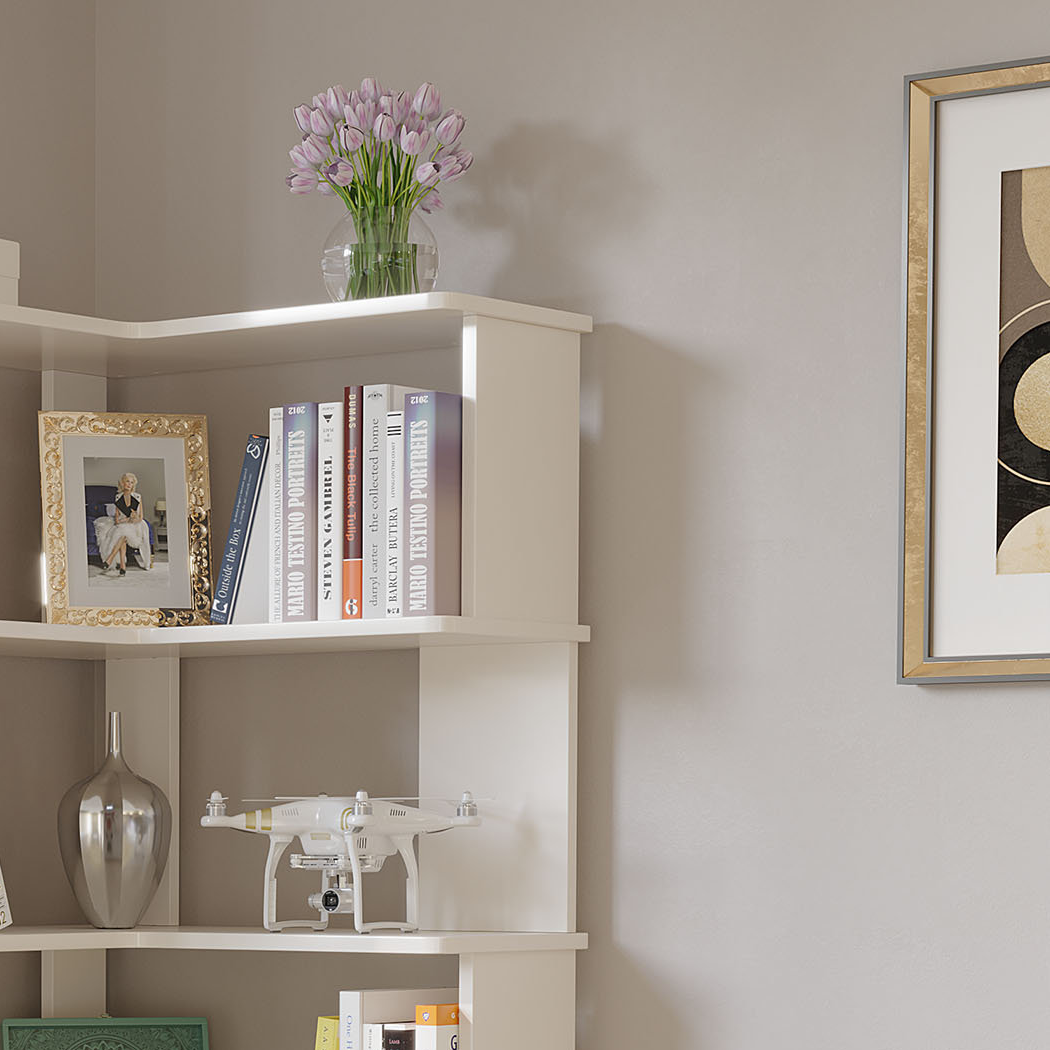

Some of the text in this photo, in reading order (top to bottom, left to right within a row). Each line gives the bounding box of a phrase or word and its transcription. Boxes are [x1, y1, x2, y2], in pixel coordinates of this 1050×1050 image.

[288, 406, 305, 414] 2012
[348, 394, 356, 429] DUMAS
[410, 396, 429, 404] 2012
[287, 430, 305, 616] MARIO TESTINO PORTREITS
[346, 448, 357, 542] The Black Tulip
[369, 419, 380, 607] darryl carter the collected home
[410, 420, 427, 610] MARIO TESTINO PORTREITS
[323, 456, 332, 600] STEVEN GAMBREL
[388, 507, 398, 549] BUTERA
[219, 528, 242, 598] Outside the Box
[274, 566, 281, 576] OF
[388, 554, 398, 602] BARCLAY
